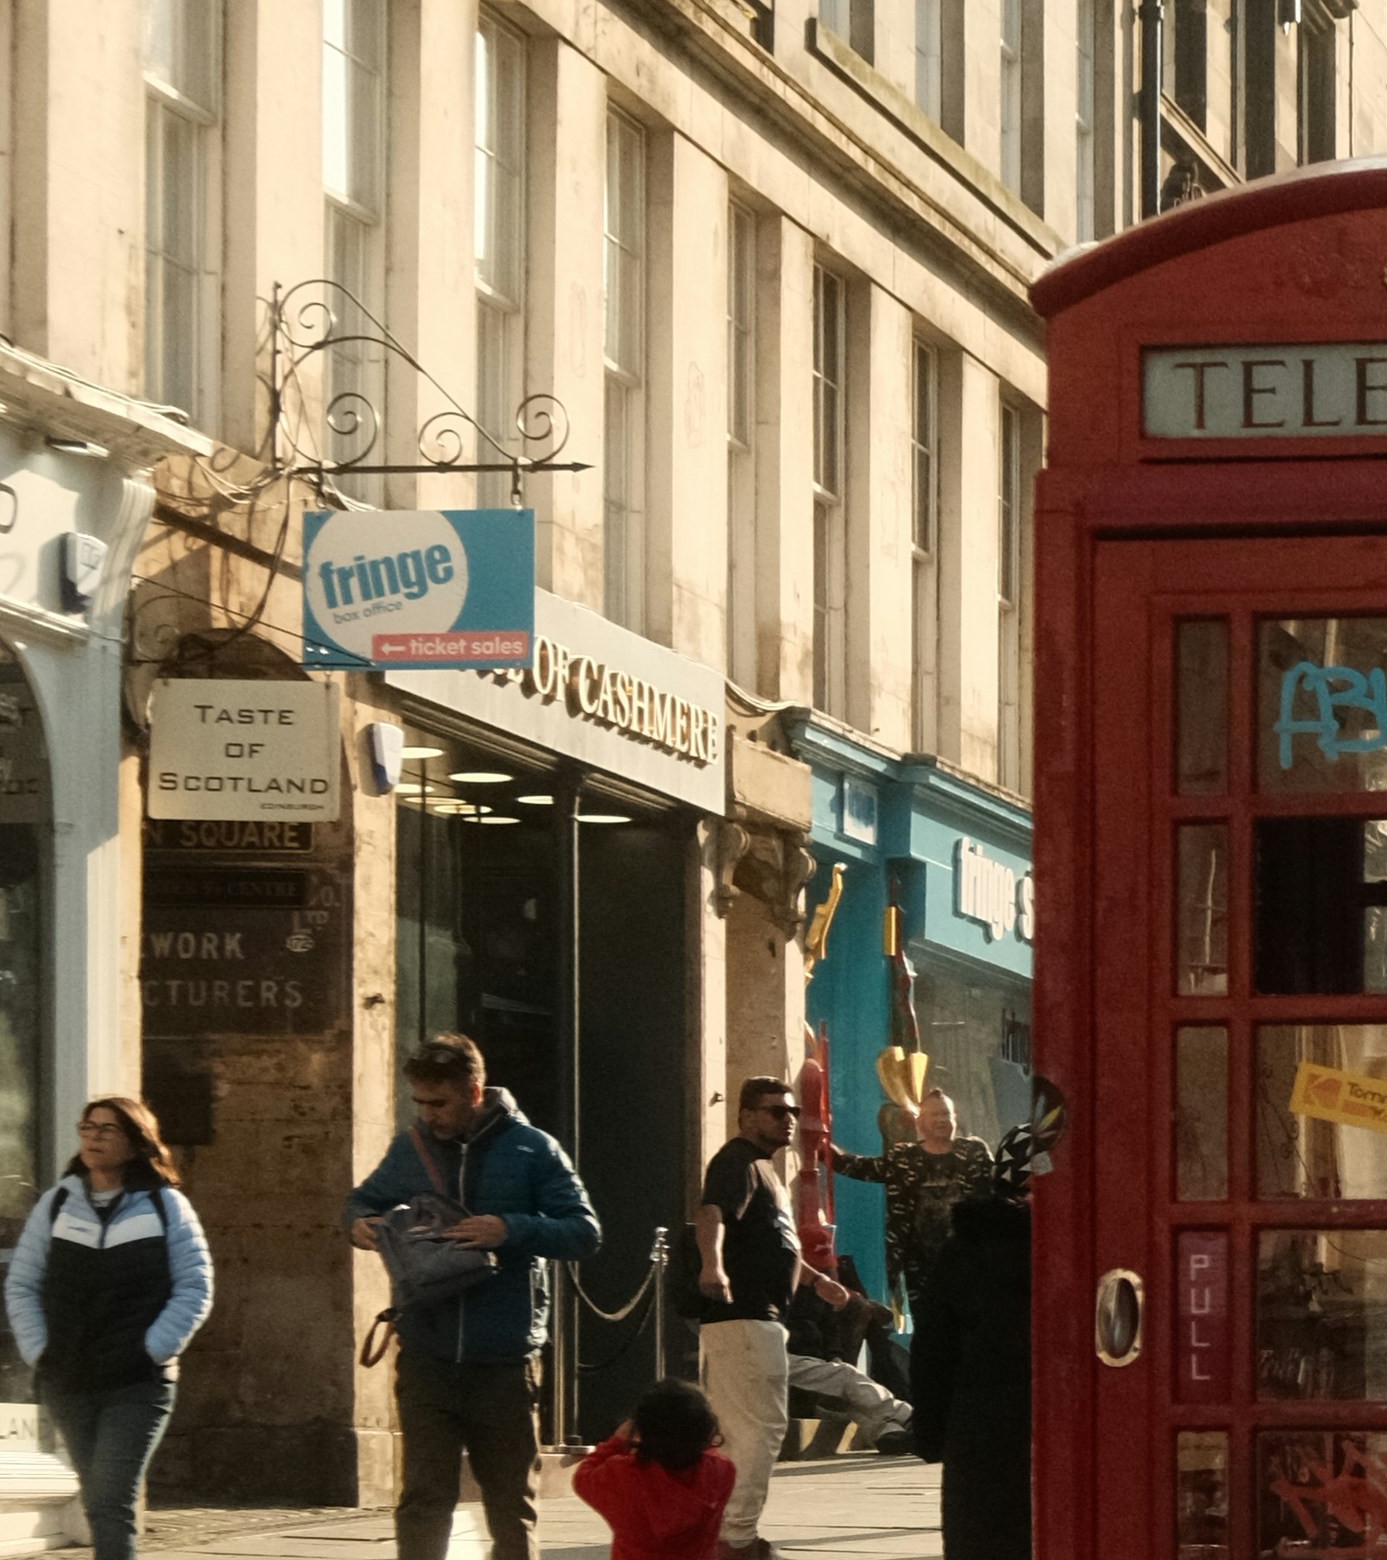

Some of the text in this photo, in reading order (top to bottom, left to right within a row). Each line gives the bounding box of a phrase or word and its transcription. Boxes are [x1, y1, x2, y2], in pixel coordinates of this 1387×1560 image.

[318, 543, 454, 609] fringe
[333, 600, 403, 624] box office
[409, 636, 523, 656] ticket sales
[532, 635, 720, 766] OF CASHMERE
[193, 704, 296, 726] TASTE
[224, 742, 265, 759] OF
[158, 772, 330, 795] SCOTLAND
[180, 820, 300, 848] SQUARE
[955, 836, 1016, 941] fringe
[143, 931, 244, 960] WORK
[1189, 1254, 1211, 1381] PULL
